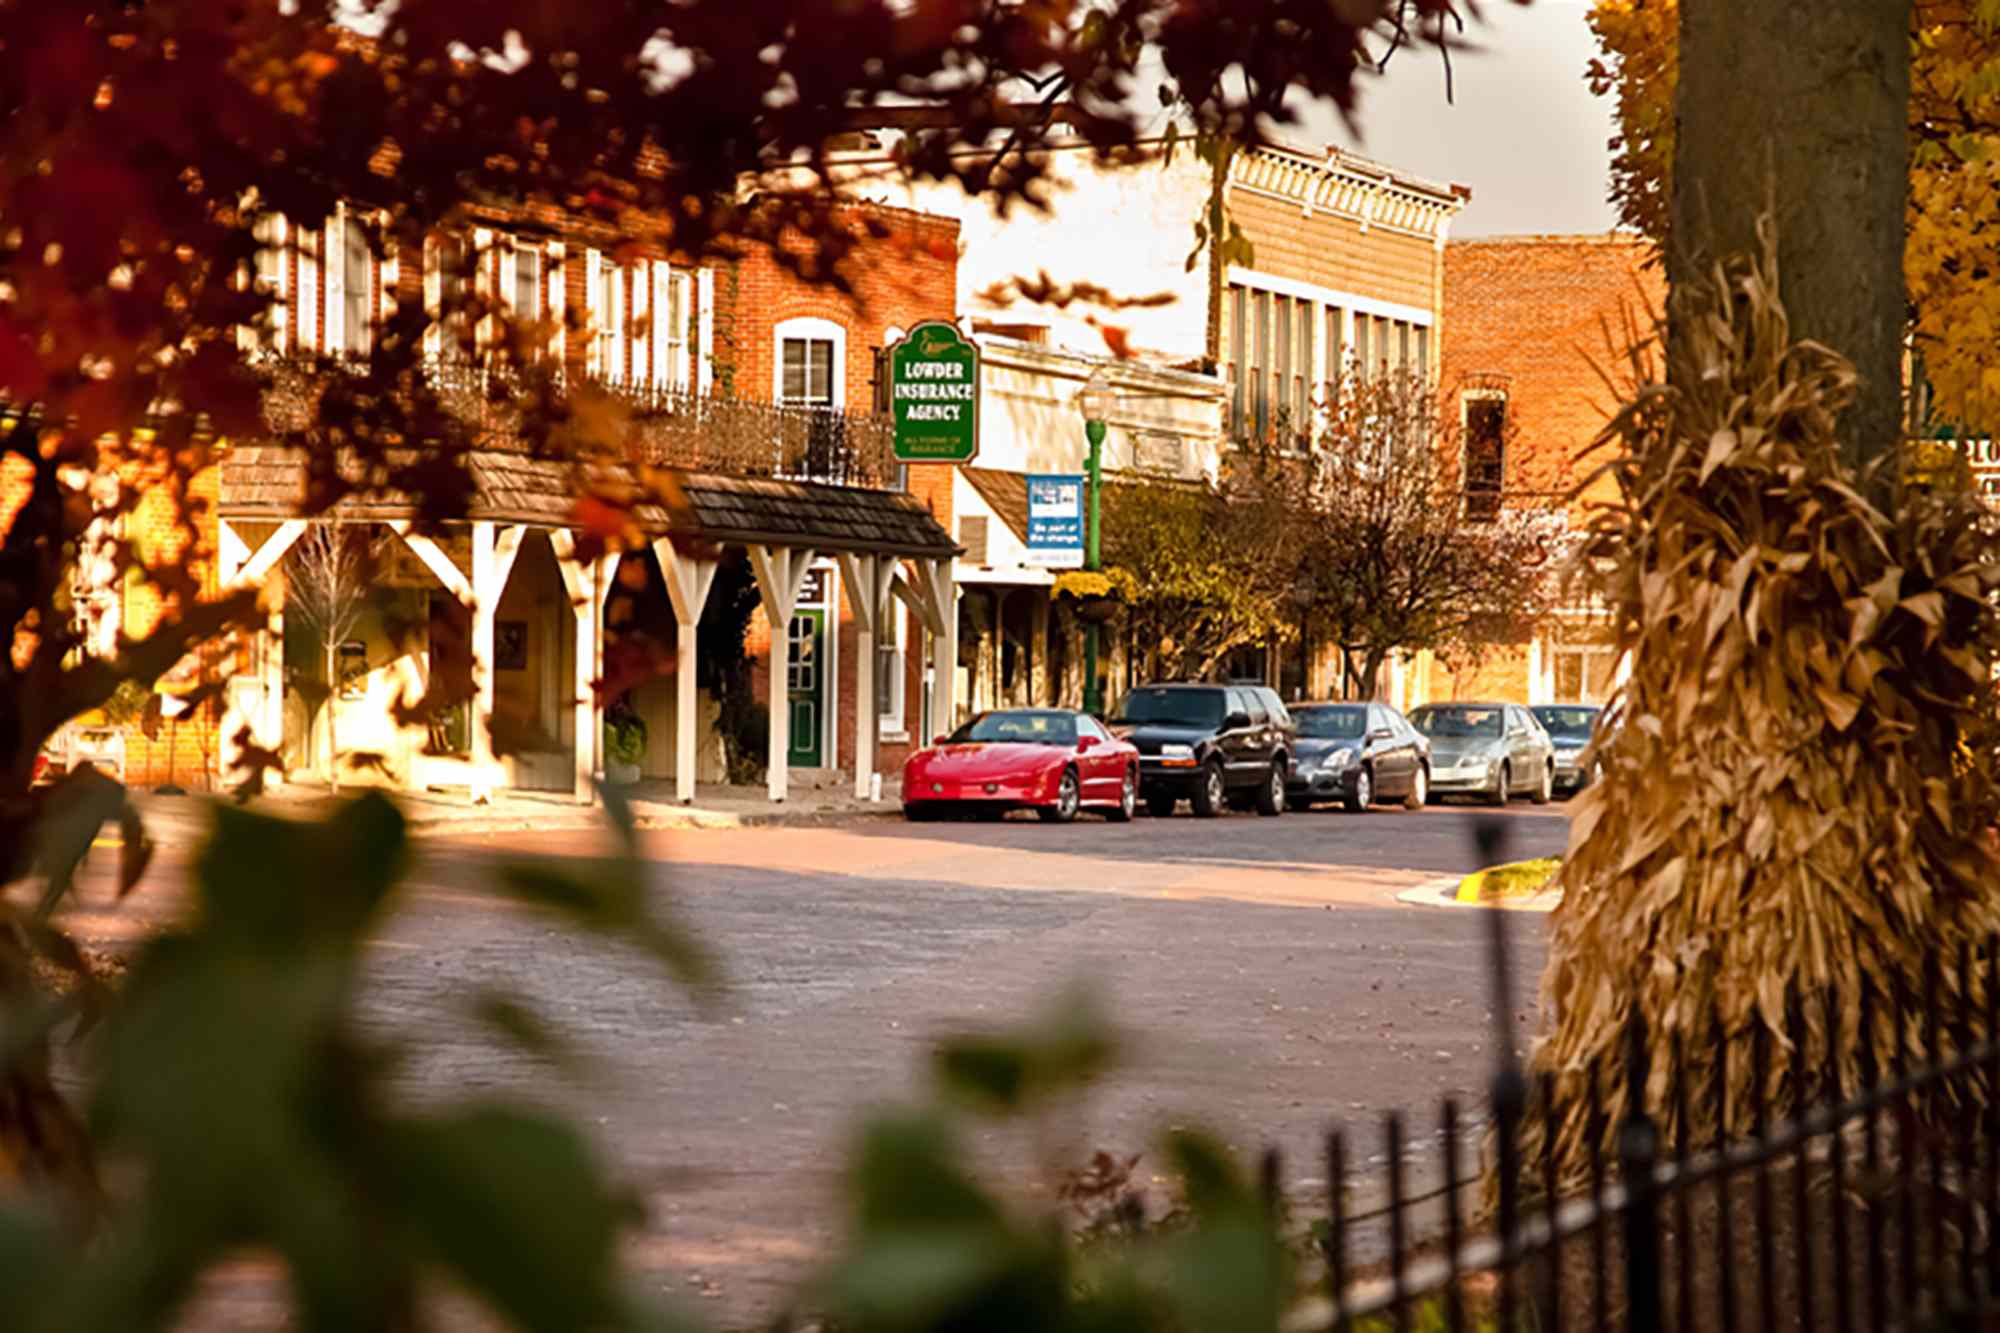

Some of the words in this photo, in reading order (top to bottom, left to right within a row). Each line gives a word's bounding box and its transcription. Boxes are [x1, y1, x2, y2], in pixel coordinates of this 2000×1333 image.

[904, 361, 963, 379] LOWDER
[895, 383, 973, 400] INSURANCE
[906, 404, 960, 420] AGENCY
